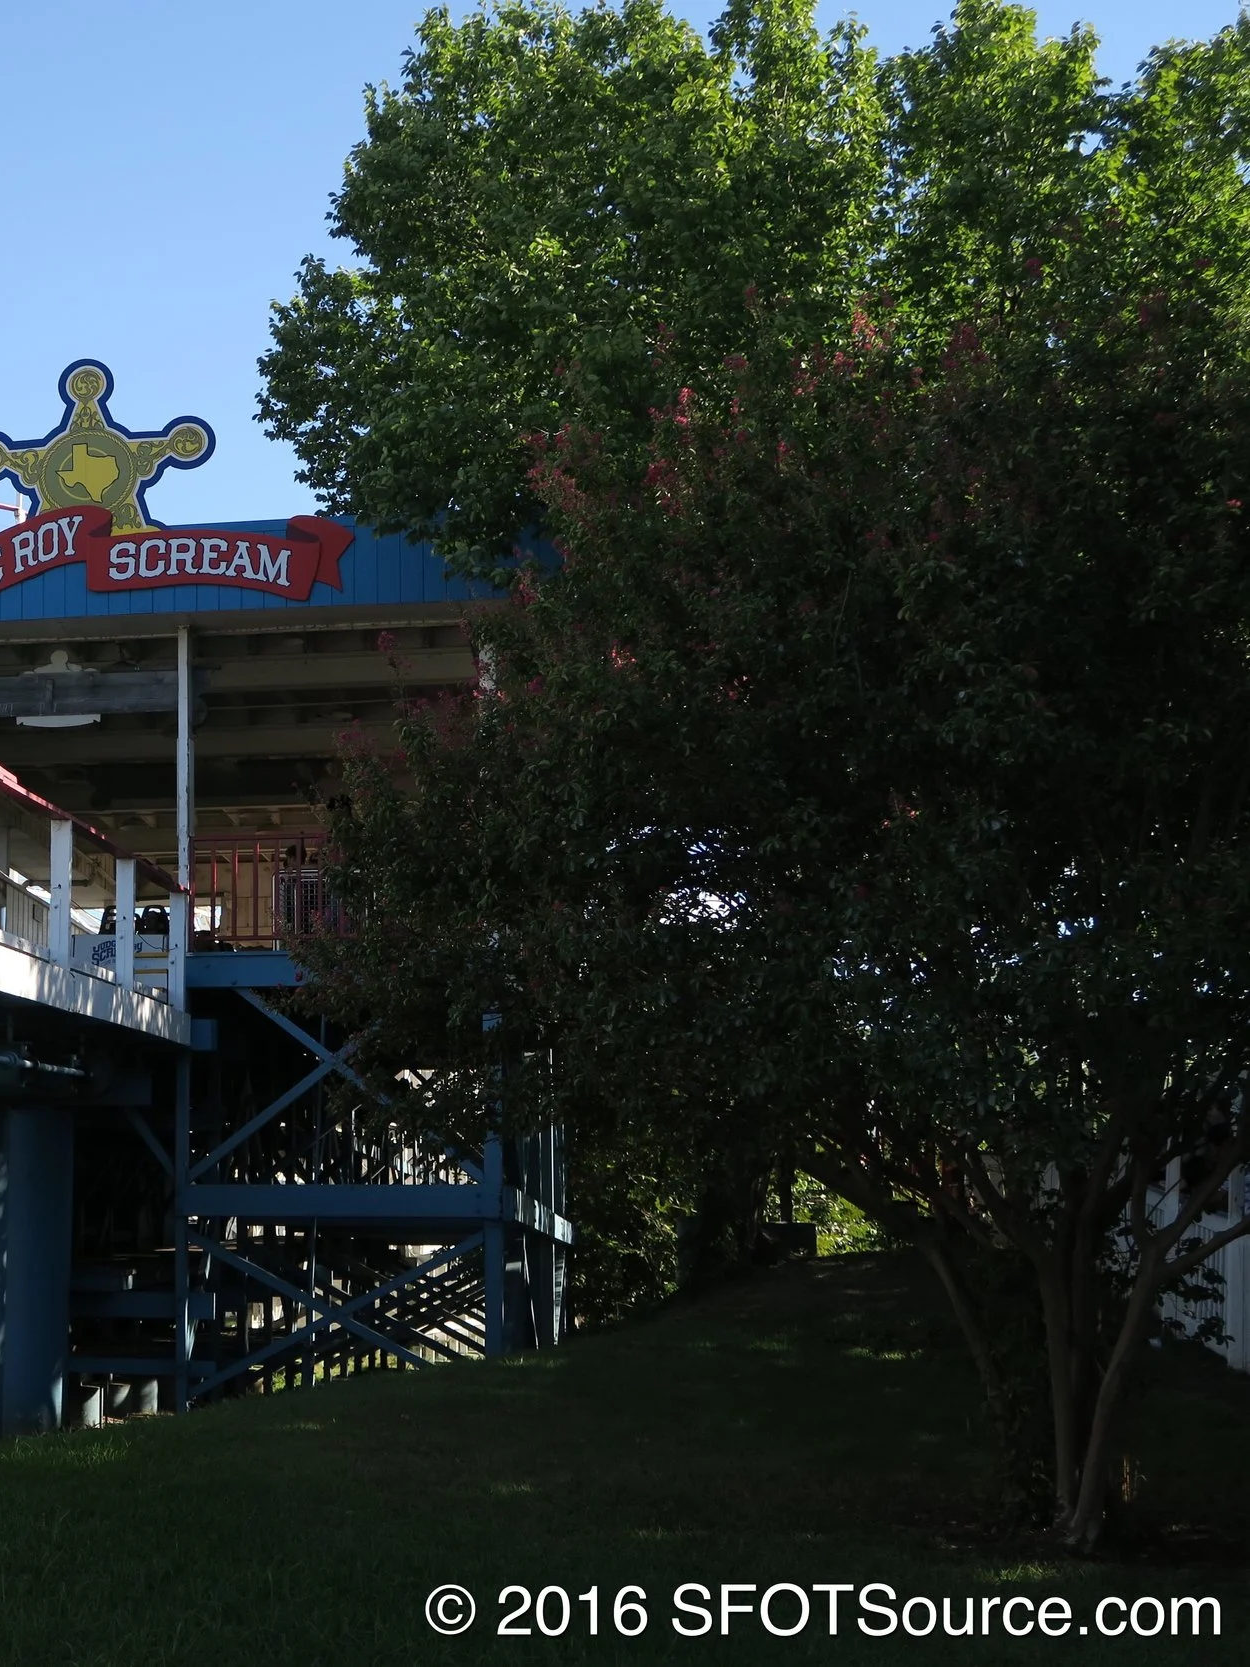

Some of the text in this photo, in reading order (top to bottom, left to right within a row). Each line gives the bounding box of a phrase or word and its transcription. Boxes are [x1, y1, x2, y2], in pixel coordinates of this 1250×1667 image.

[12, 516, 83, 574] ROY
[108, 537, 291, 587] SCREAM
[92, 940, 116, 953] JUDG
